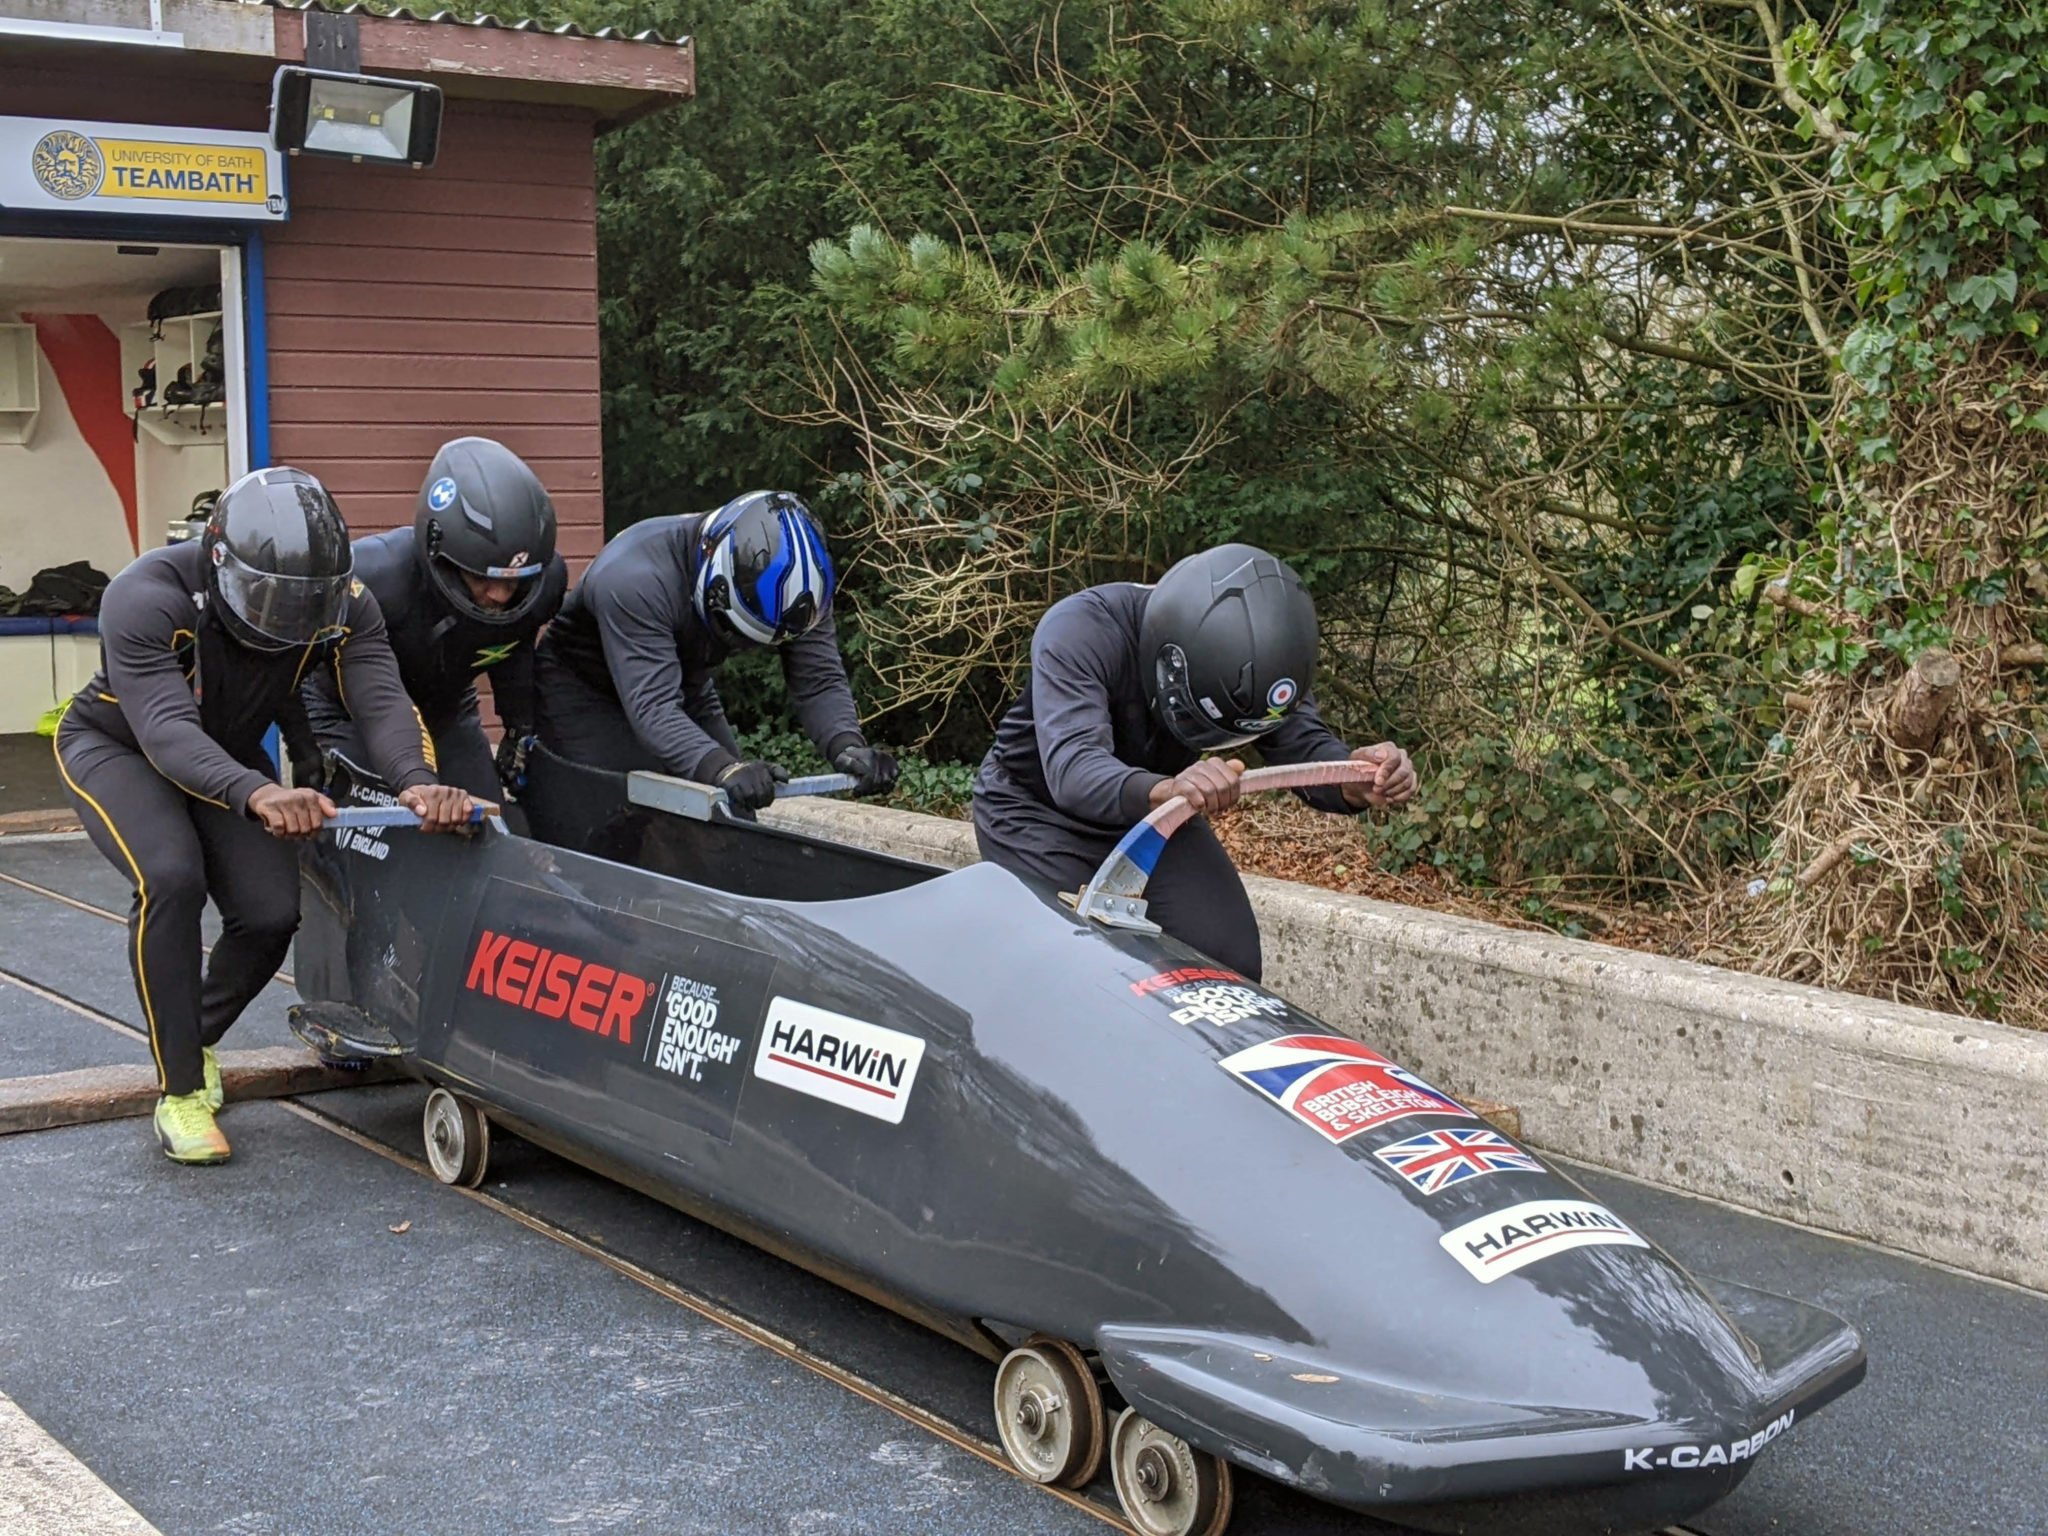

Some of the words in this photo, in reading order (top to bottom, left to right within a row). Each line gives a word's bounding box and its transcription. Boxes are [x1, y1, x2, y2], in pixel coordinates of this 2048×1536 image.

[112, 149, 192, 166] UNIVERSITY
[196, 157, 214, 167] OF
[218, 157, 252, 168] BATH
[350, 784, 400, 808] K-CARBO
[350, 833, 390, 860] ENGLAND
[661, 1016, 741, 1065] ENOUGH'
[1301, 1080, 1380, 1113] BRITISH
[1314, 1088, 1424, 1123] BOBSLEIGH
[1329, 1118, 1352, 1132] &
[1347, 1098, 1444, 1125] SKELETON
[1623, 1408, 1796, 1472] K-CARBON
